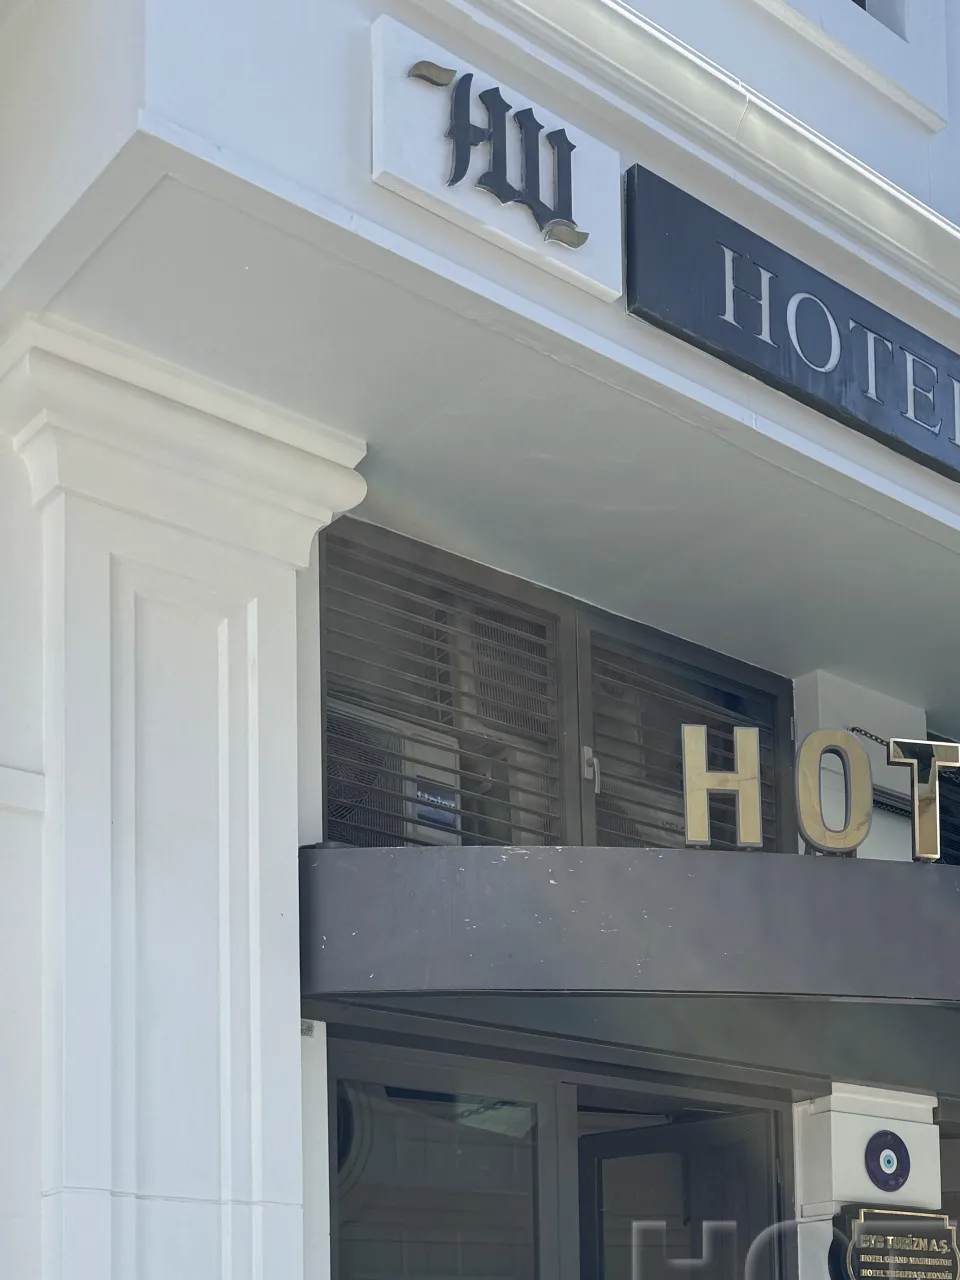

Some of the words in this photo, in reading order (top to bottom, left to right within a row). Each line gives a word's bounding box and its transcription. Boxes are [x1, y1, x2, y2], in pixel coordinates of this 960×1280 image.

[860, 1255, 884, 1264] HOTEL
[885, 1256, 909, 1265] GRAND
[860, 1269, 885, 1278] HOTEL
